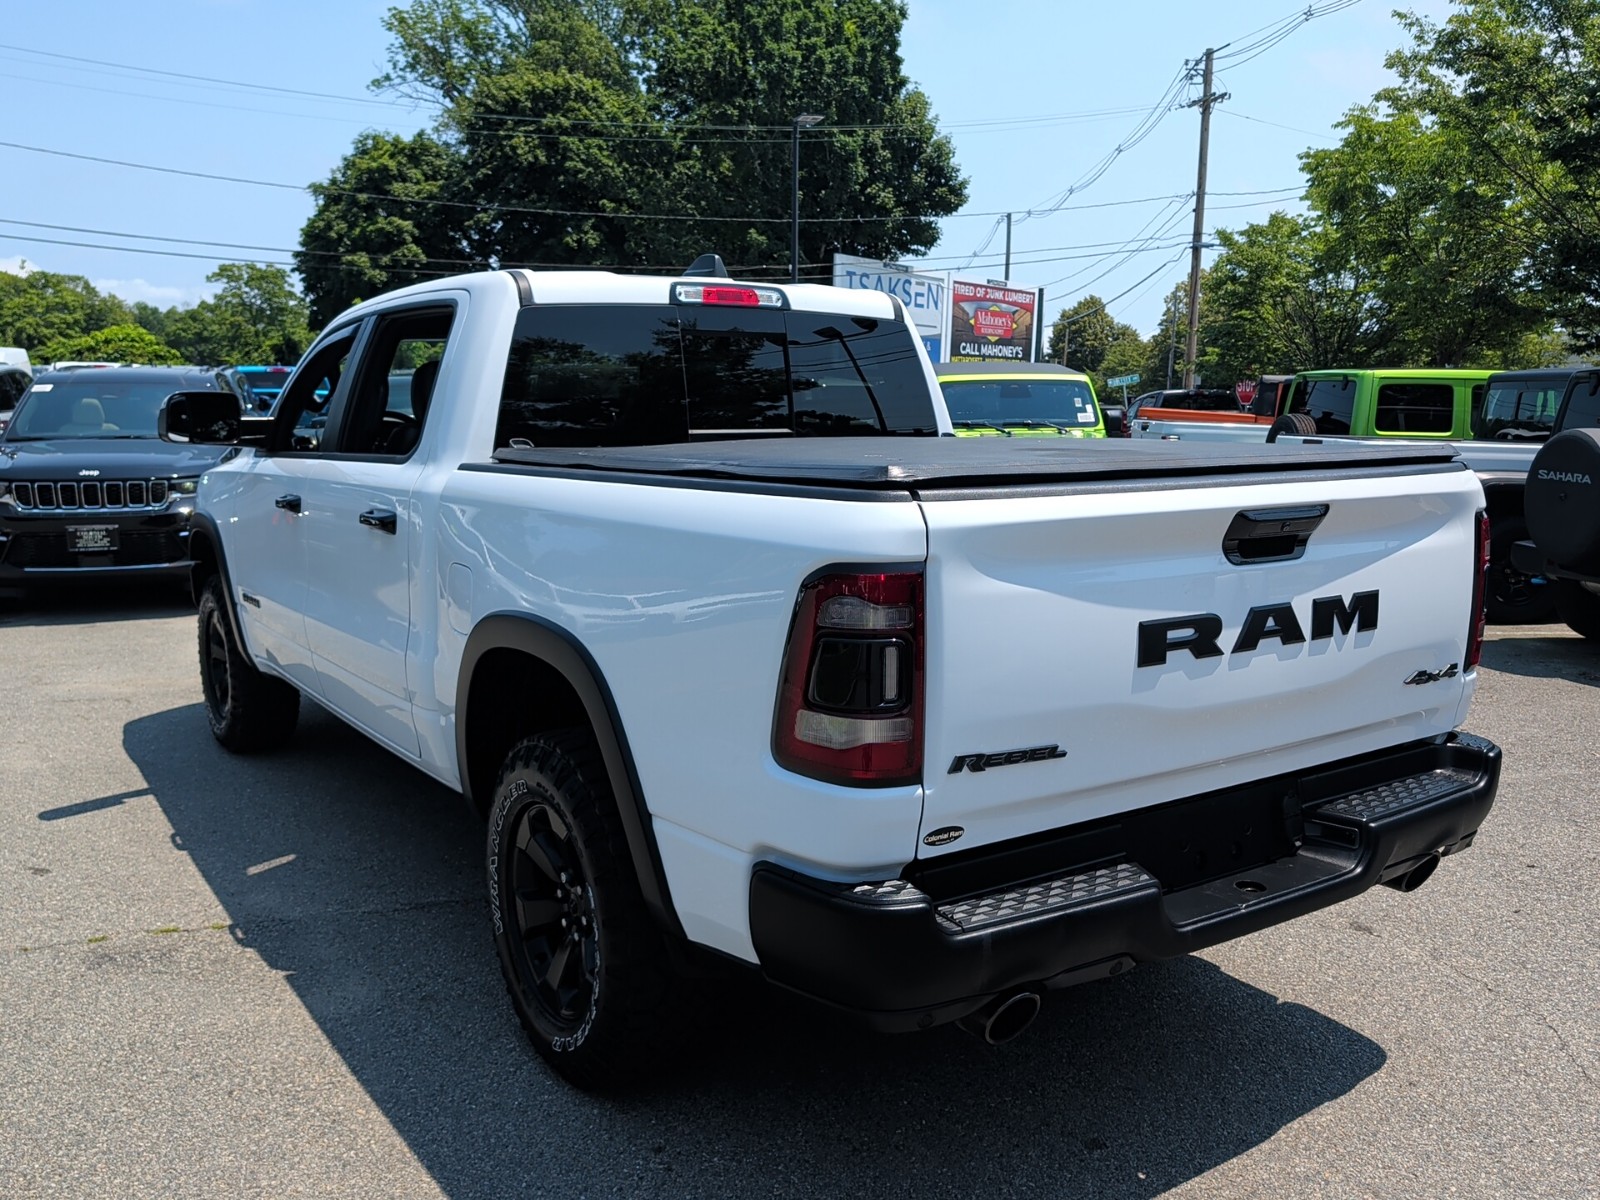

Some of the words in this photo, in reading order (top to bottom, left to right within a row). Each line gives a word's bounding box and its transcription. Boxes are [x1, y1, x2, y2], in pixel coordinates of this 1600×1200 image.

[954, 284, 975, 297] TIRED
[976, 286, 986, 298] OF
[987, 287, 1005, 300] JUNK
[1005, 290, 1034, 305] LUMBER?
[960, 341, 980, 356] CALL
[980, 343, 1023, 359] MAHONEY'S
[1237, 380, 1256, 392] STOP
[78, 469, 100, 477] Jeep
[1537, 469, 1592, 485] SAHARA
[1137, 589, 1380, 668] RAM
[947, 743, 1068, 775] REBEL
[924, 831, 950, 843] Colonial
[950, 830, 964, 838] Ram
[489, 779, 528, 936] WRANGLER
